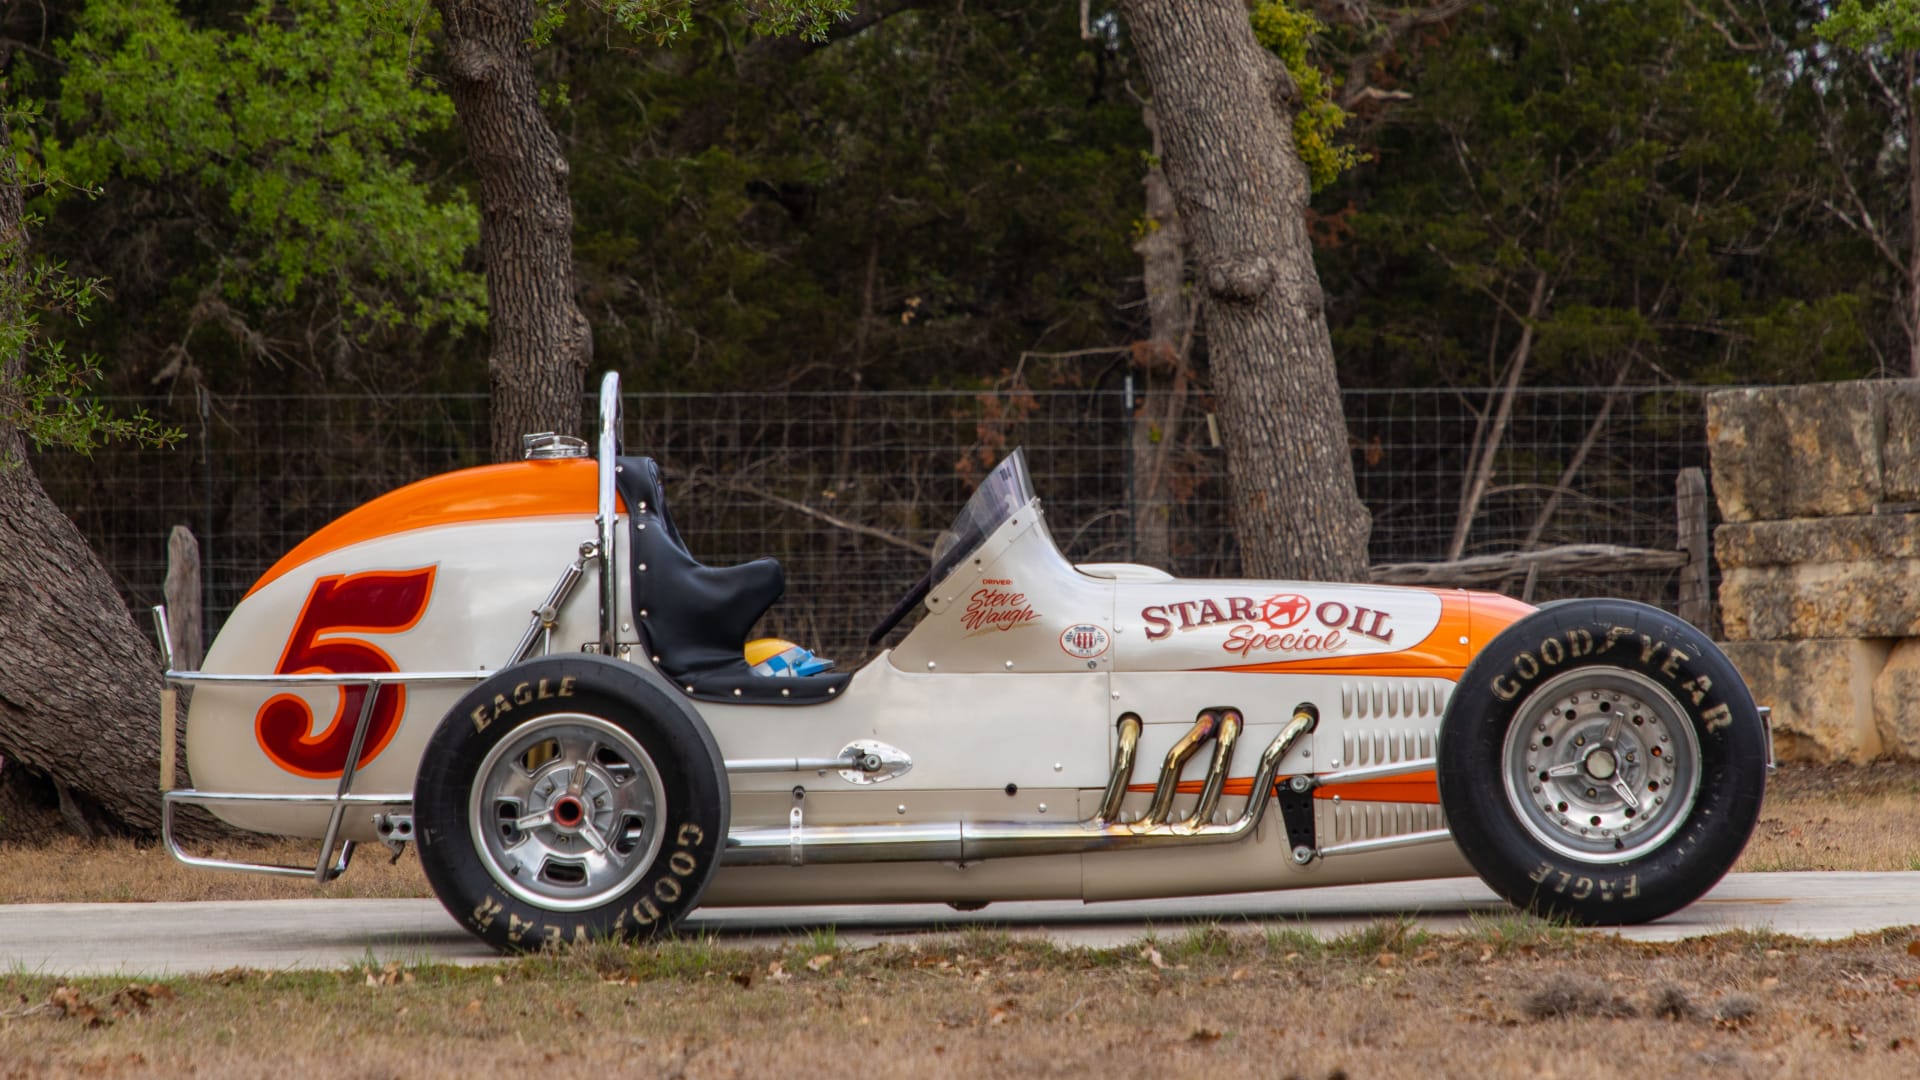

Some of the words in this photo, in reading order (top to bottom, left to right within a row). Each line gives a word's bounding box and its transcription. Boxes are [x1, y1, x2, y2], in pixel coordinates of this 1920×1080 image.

[960, 605, 1042, 632] Waugh
[966, 588, 1027, 612] Steve
[1141, 596, 1258, 643] STAR
[1315, 601, 1394, 643] OIL
[1222, 623, 1348, 657] Special
[255, 563, 438, 780] 5
[470, 675, 577, 734] EAGLE
[1528, 861, 1640, 900] EAGLE
